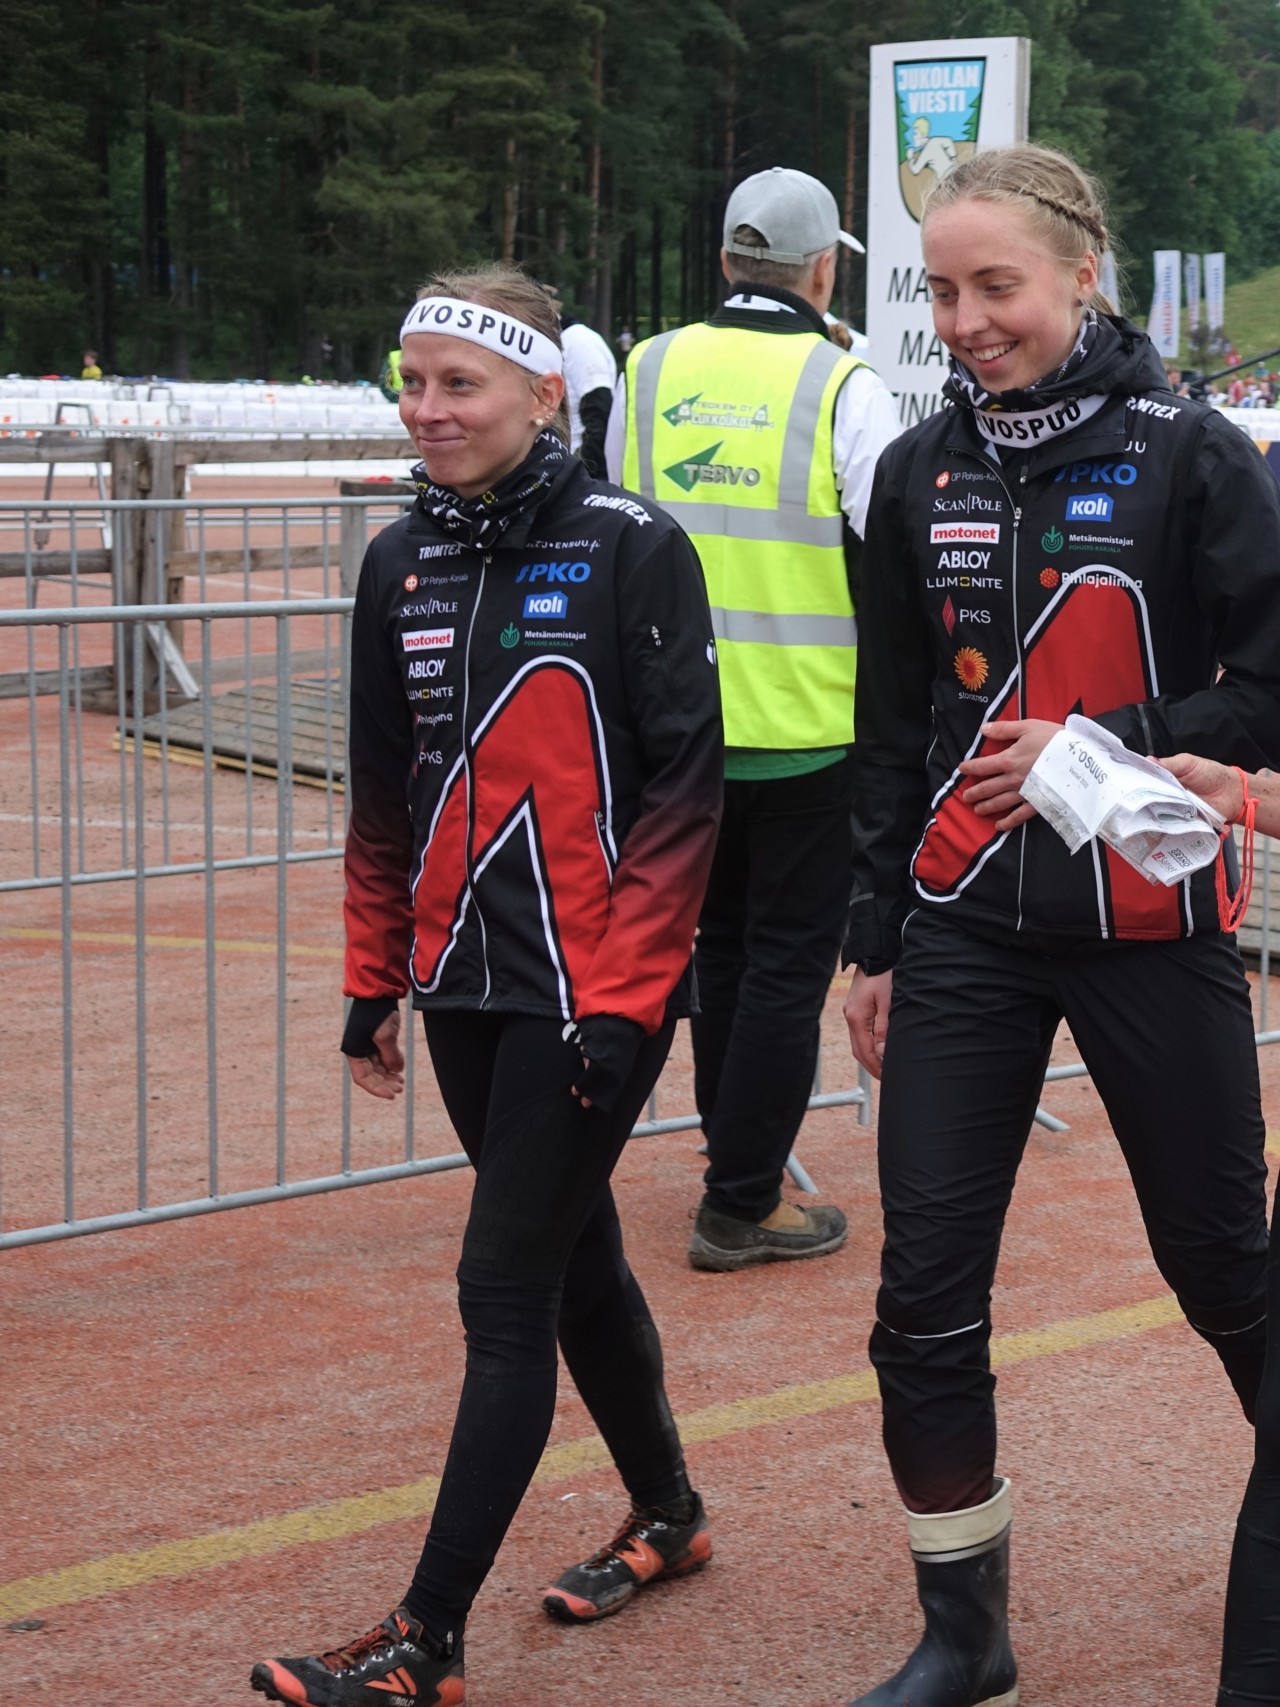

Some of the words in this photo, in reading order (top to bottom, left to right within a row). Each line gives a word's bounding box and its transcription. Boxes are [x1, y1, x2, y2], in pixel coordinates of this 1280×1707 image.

[897, 65, 979, 90] JUKOLAN
[909, 90, 966, 114] VIESTI
[887, 267, 932, 303] MA
[683, 462, 761, 488] TERVO
[583, 494, 654, 527] TRIMTEX
[933, 526, 997, 541] motonet
[1068, 533, 1134, 547] Metsänomistajat
[419, 544, 462, 561] TRIMTEX
[937, 550, 992, 570] ABLOY
[960, 608, 992, 624] PKS
[404, 633, 453, 648] motonet
[524, 630, 587, 642] Metsänomistajat
[408, 658, 446, 680] ABLOY
[418, 750, 443, 765] PKS
